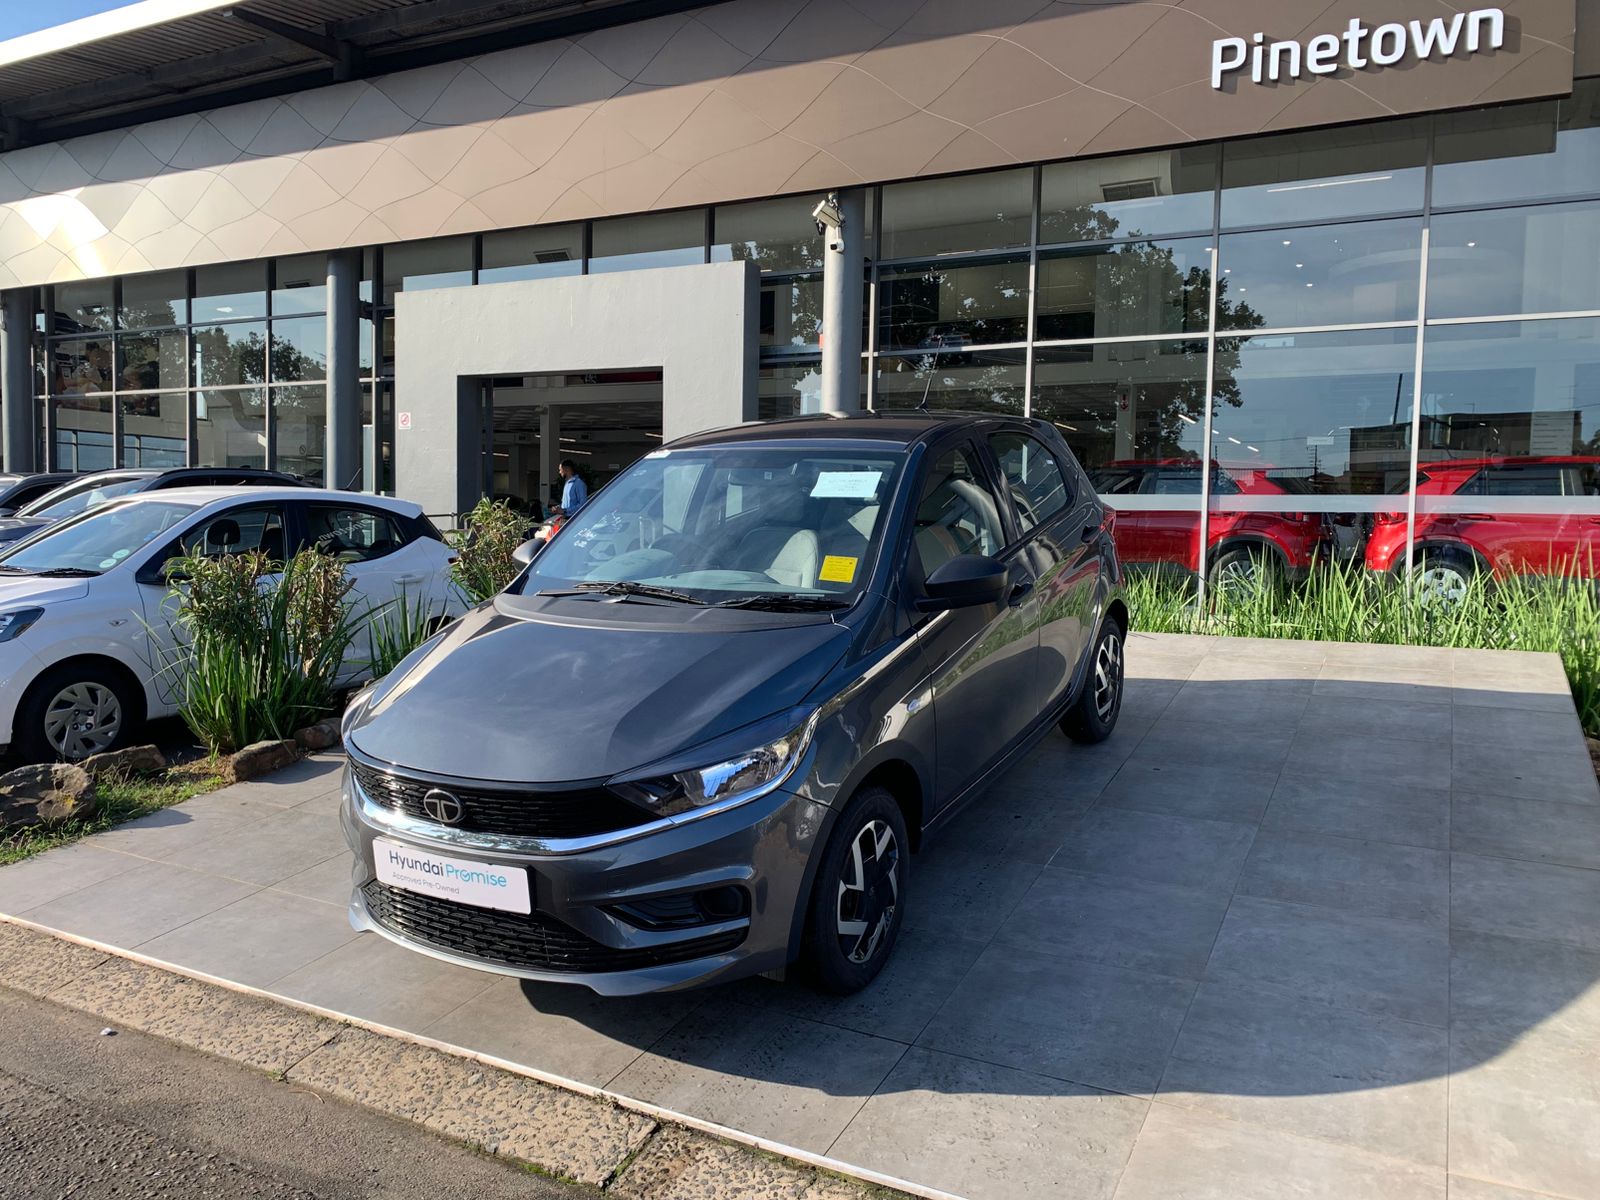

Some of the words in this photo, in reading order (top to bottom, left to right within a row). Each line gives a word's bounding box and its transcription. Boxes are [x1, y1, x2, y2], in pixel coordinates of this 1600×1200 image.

[1211, 7, 1504, 89] Pinetown
[389, 850, 444, 877] Hyundai
[445, 863, 507, 888] Promise
[392, 871, 422, 886] Approved
[422, 878, 460, 895] Pre-Owned
